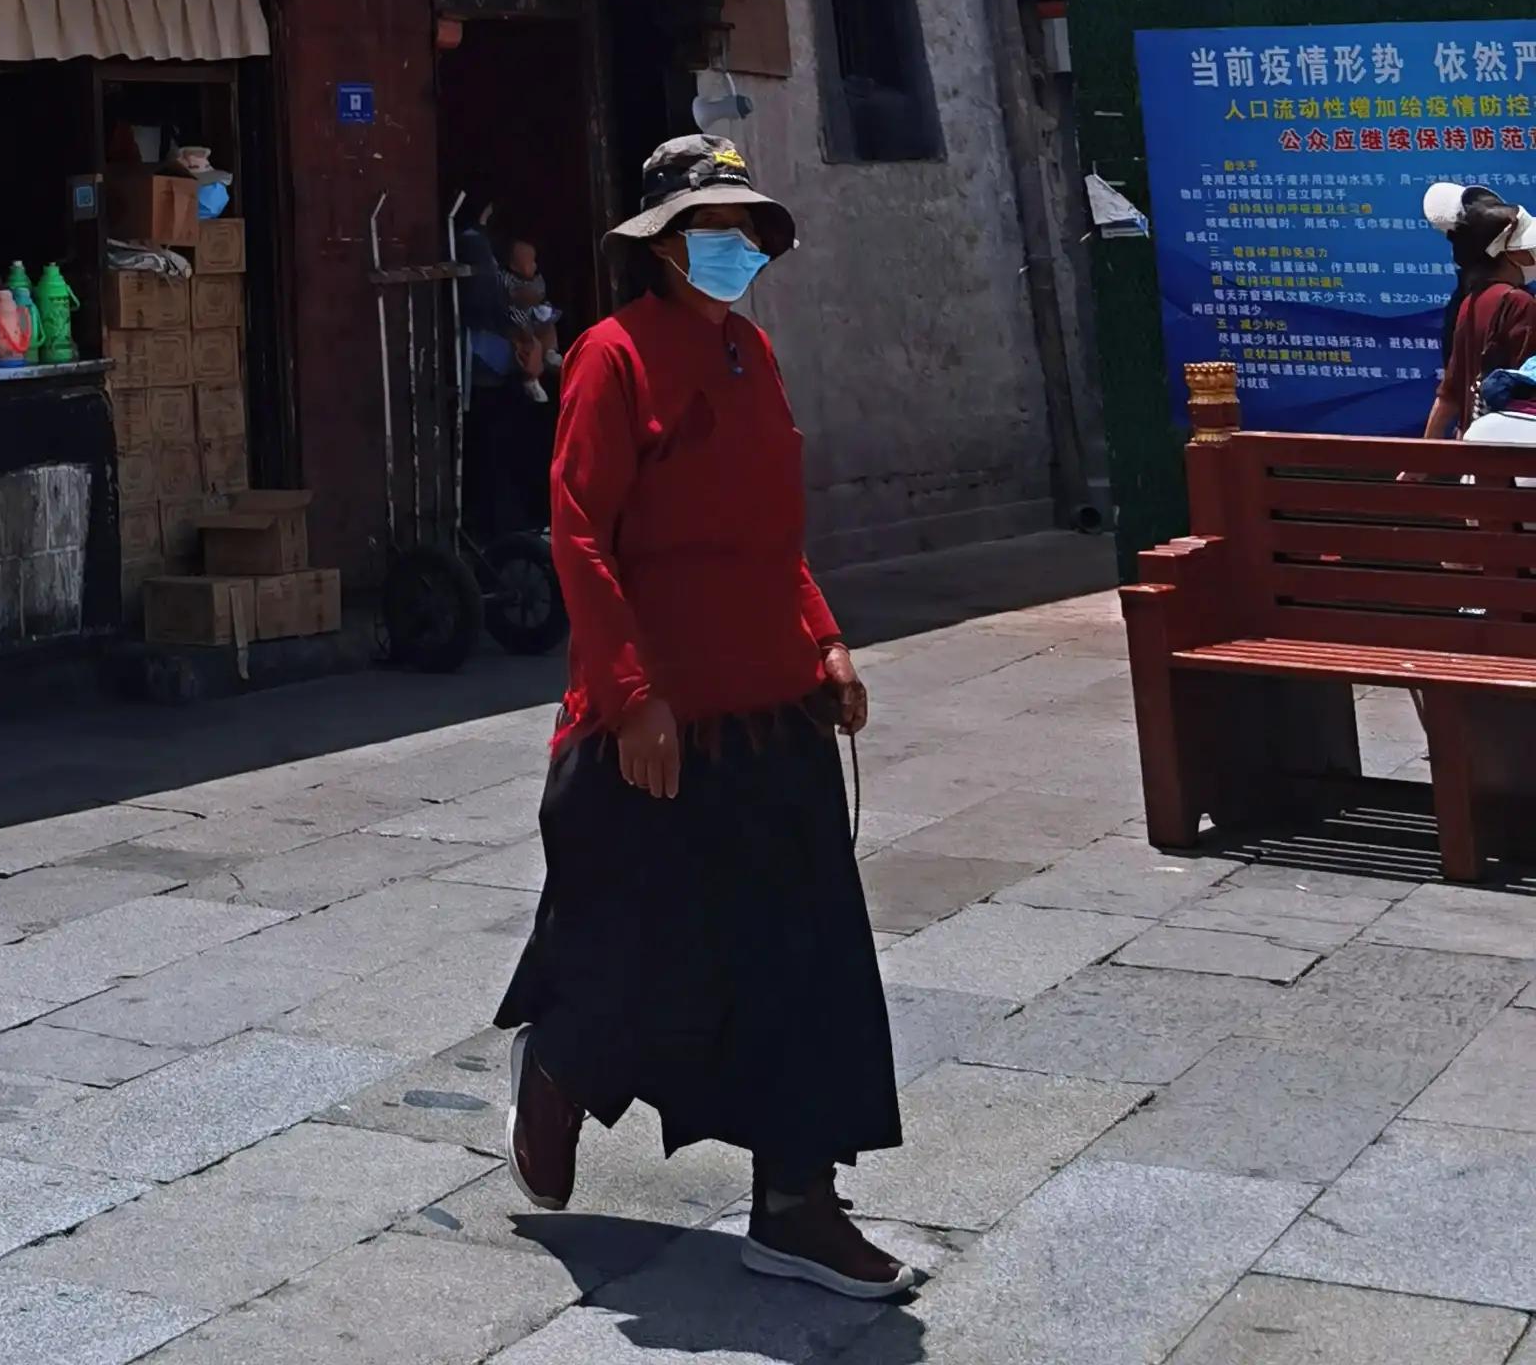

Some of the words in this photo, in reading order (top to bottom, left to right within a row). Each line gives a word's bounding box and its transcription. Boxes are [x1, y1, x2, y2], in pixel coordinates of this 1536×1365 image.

[1190, 42, 1405, 88] 当前疫情形势
[1224, 94, 1536, 121] 人口流动性增加给疫情防控
